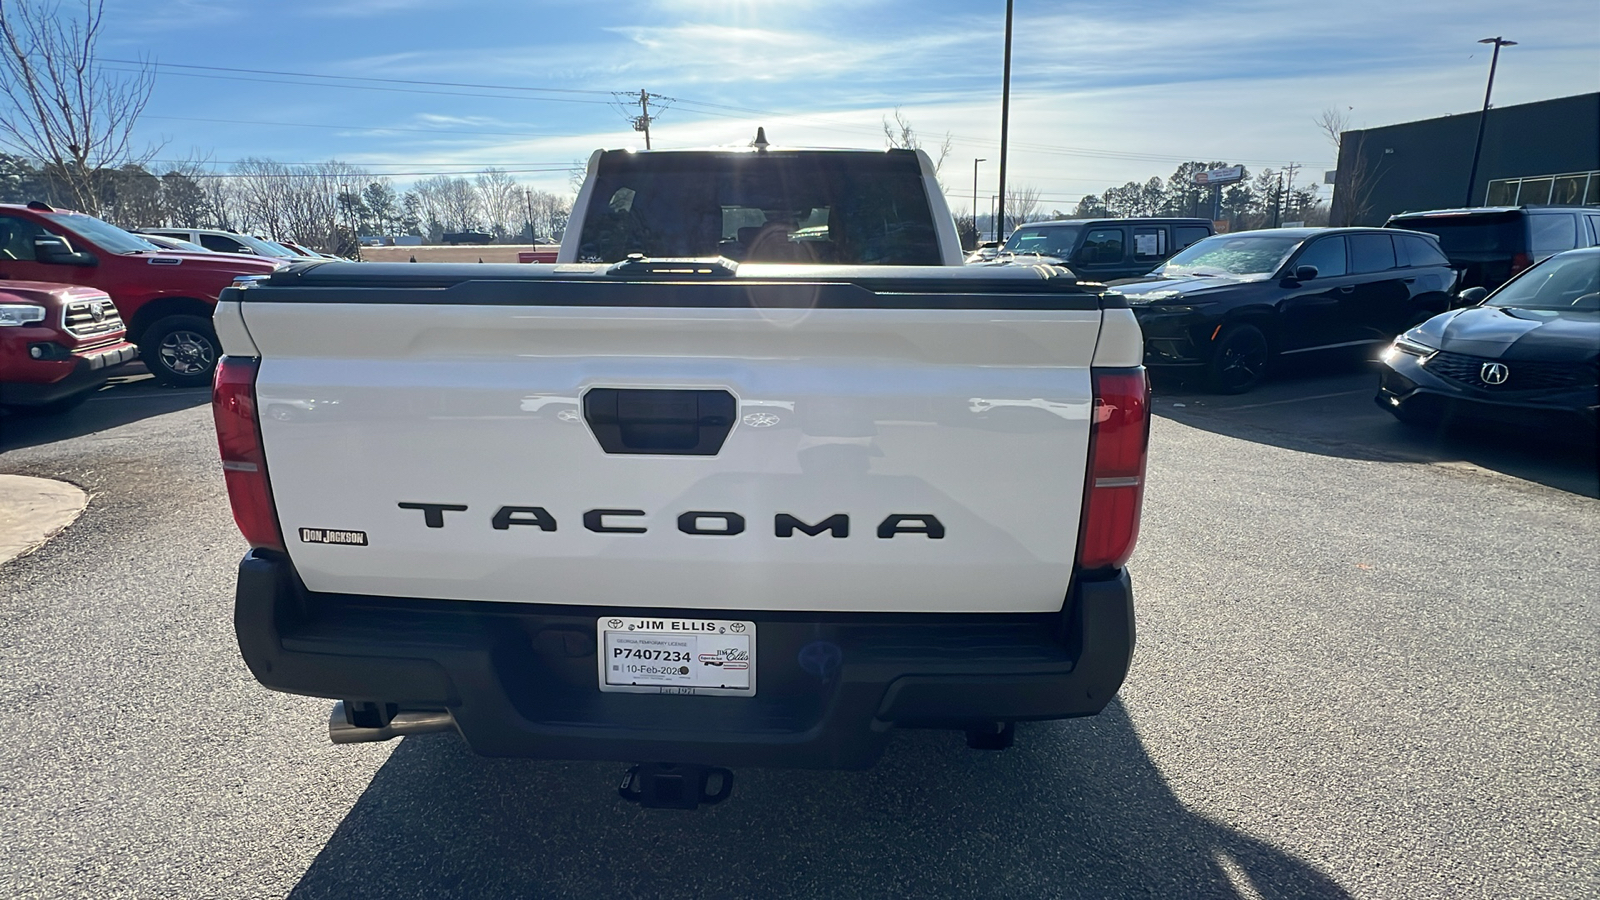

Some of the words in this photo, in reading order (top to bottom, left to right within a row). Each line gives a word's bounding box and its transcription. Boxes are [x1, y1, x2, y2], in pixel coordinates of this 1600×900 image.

[398, 502, 945, 539] TACOMA
[637, 620, 664, 630] JIM
[671, 621, 716, 631] ELLIS
[613, 648, 692, 663] P7407234
[725, 648, 749, 661] Ellis
